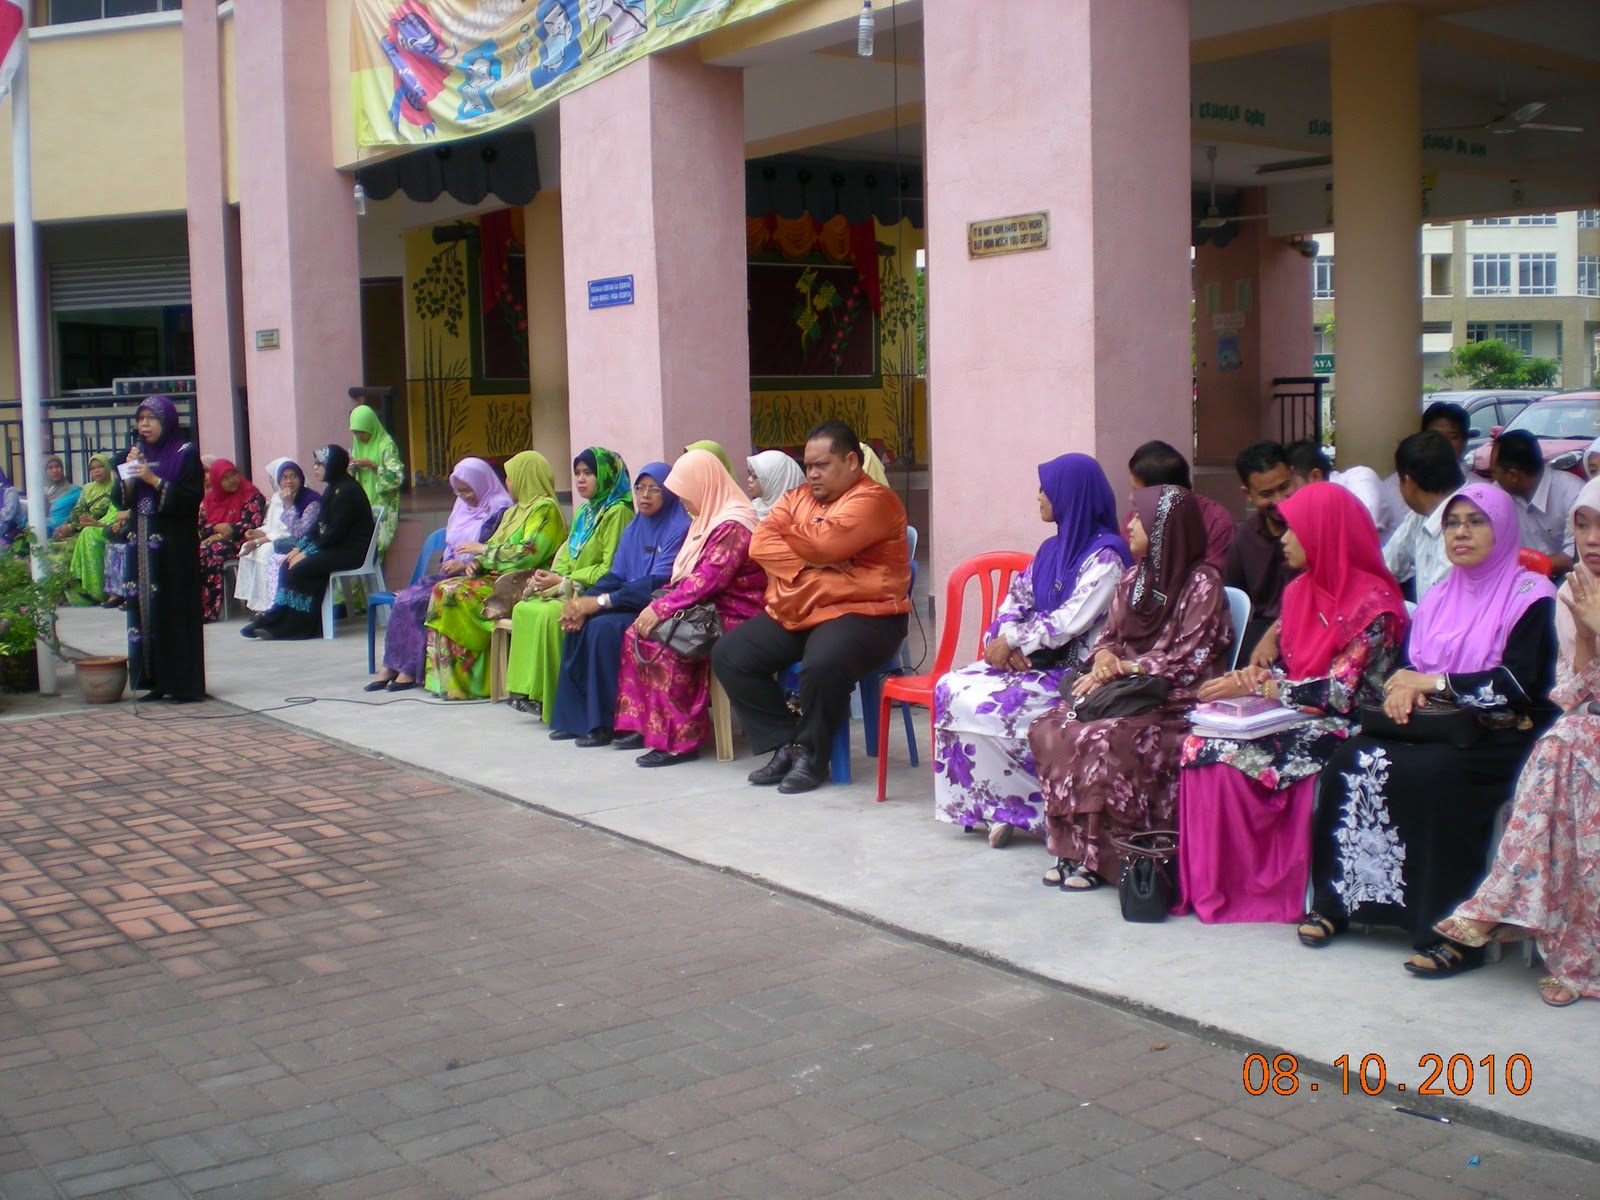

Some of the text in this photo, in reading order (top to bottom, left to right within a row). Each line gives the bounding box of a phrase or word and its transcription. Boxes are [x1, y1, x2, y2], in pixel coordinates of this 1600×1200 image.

[983, 225, 993, 236] NOT
[1004, 222, 1017, 233] HARD
[1018, 221, 1028, 230] YOU
[1029, 219, 1043, 229] WORK
[974, 240, 983, 250] BUT
[1010, 235, 1019, 245] YOU
[1020, 233, 1029, 243] GET
[1030, 232, 1043, 243] DONE
